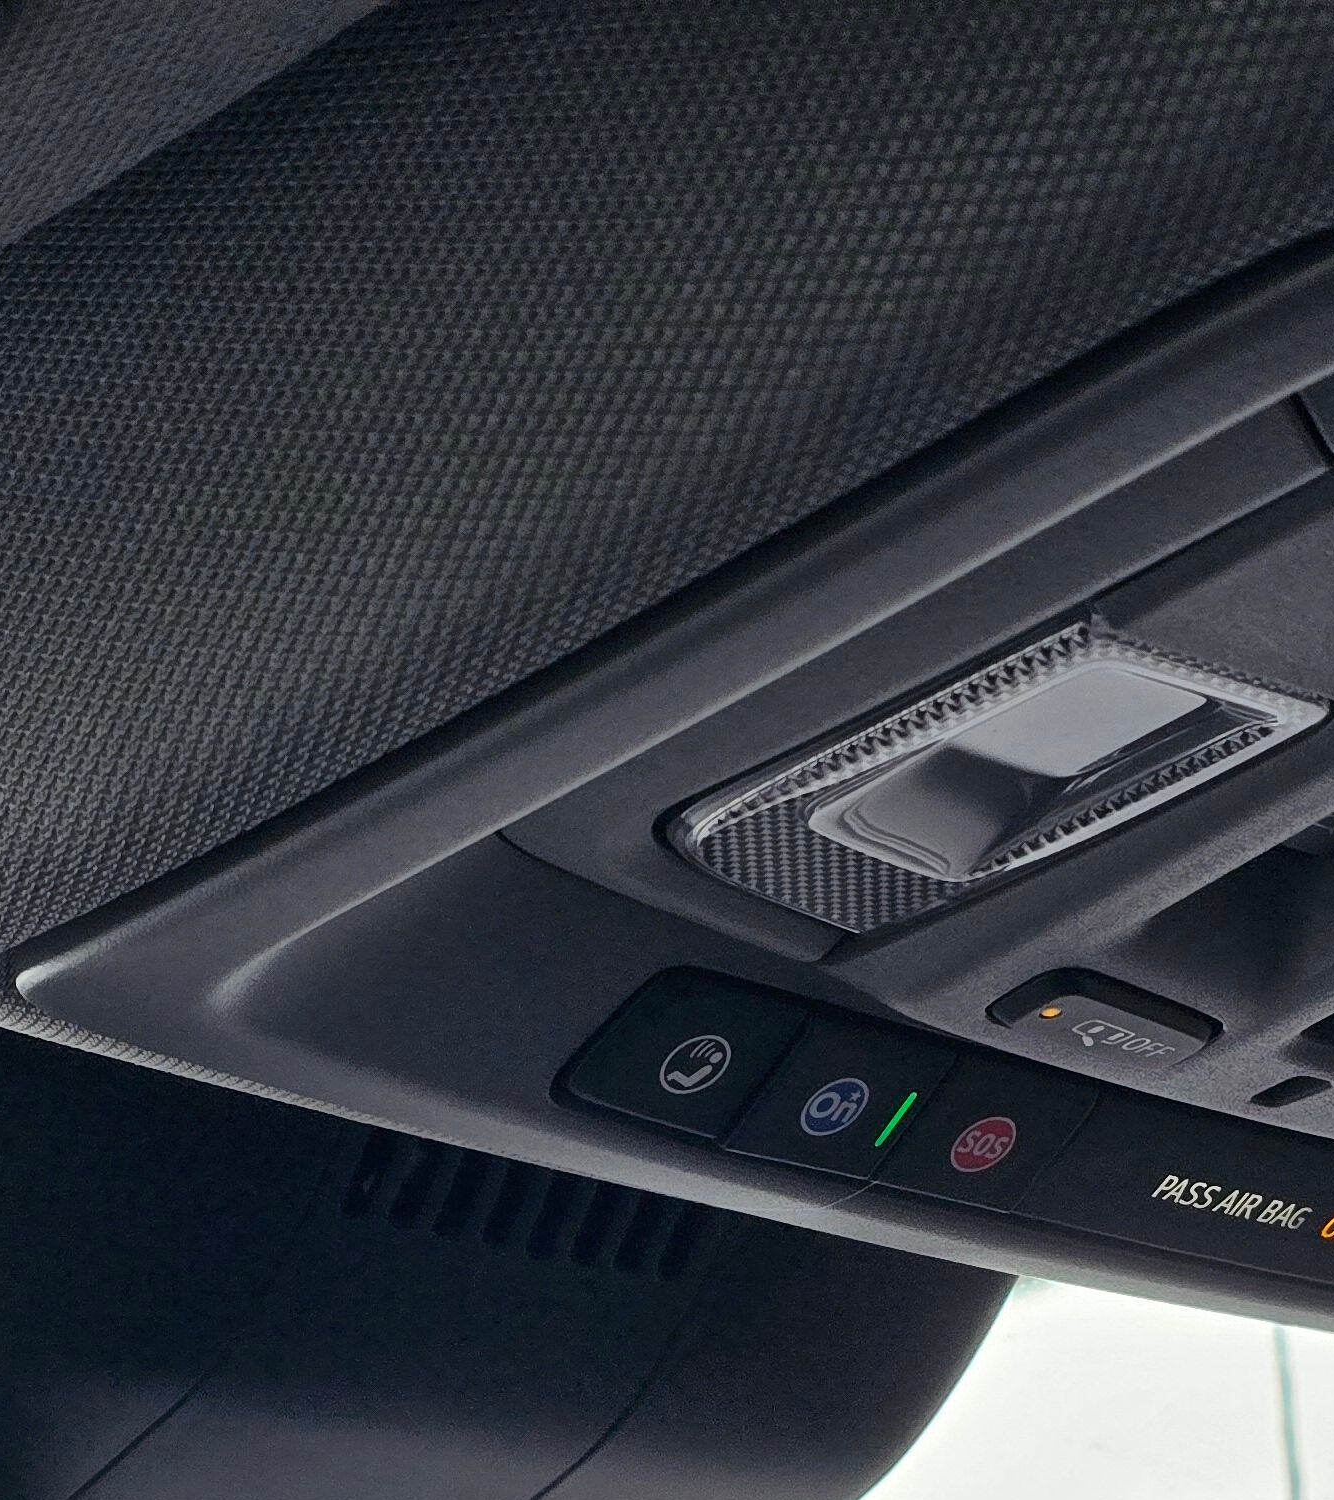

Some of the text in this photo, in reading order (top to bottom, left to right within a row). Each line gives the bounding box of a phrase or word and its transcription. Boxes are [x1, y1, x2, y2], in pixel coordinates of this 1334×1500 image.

[1121, 1037, 1176, 1058] OFF
[957, 1129, 1010, 1159] SOS
[1151, 1174, 1222, 1210] PASS
[1212, 1189, 1263, 1221] AIR
[1256, 1199, 1313, 1230] BAG
